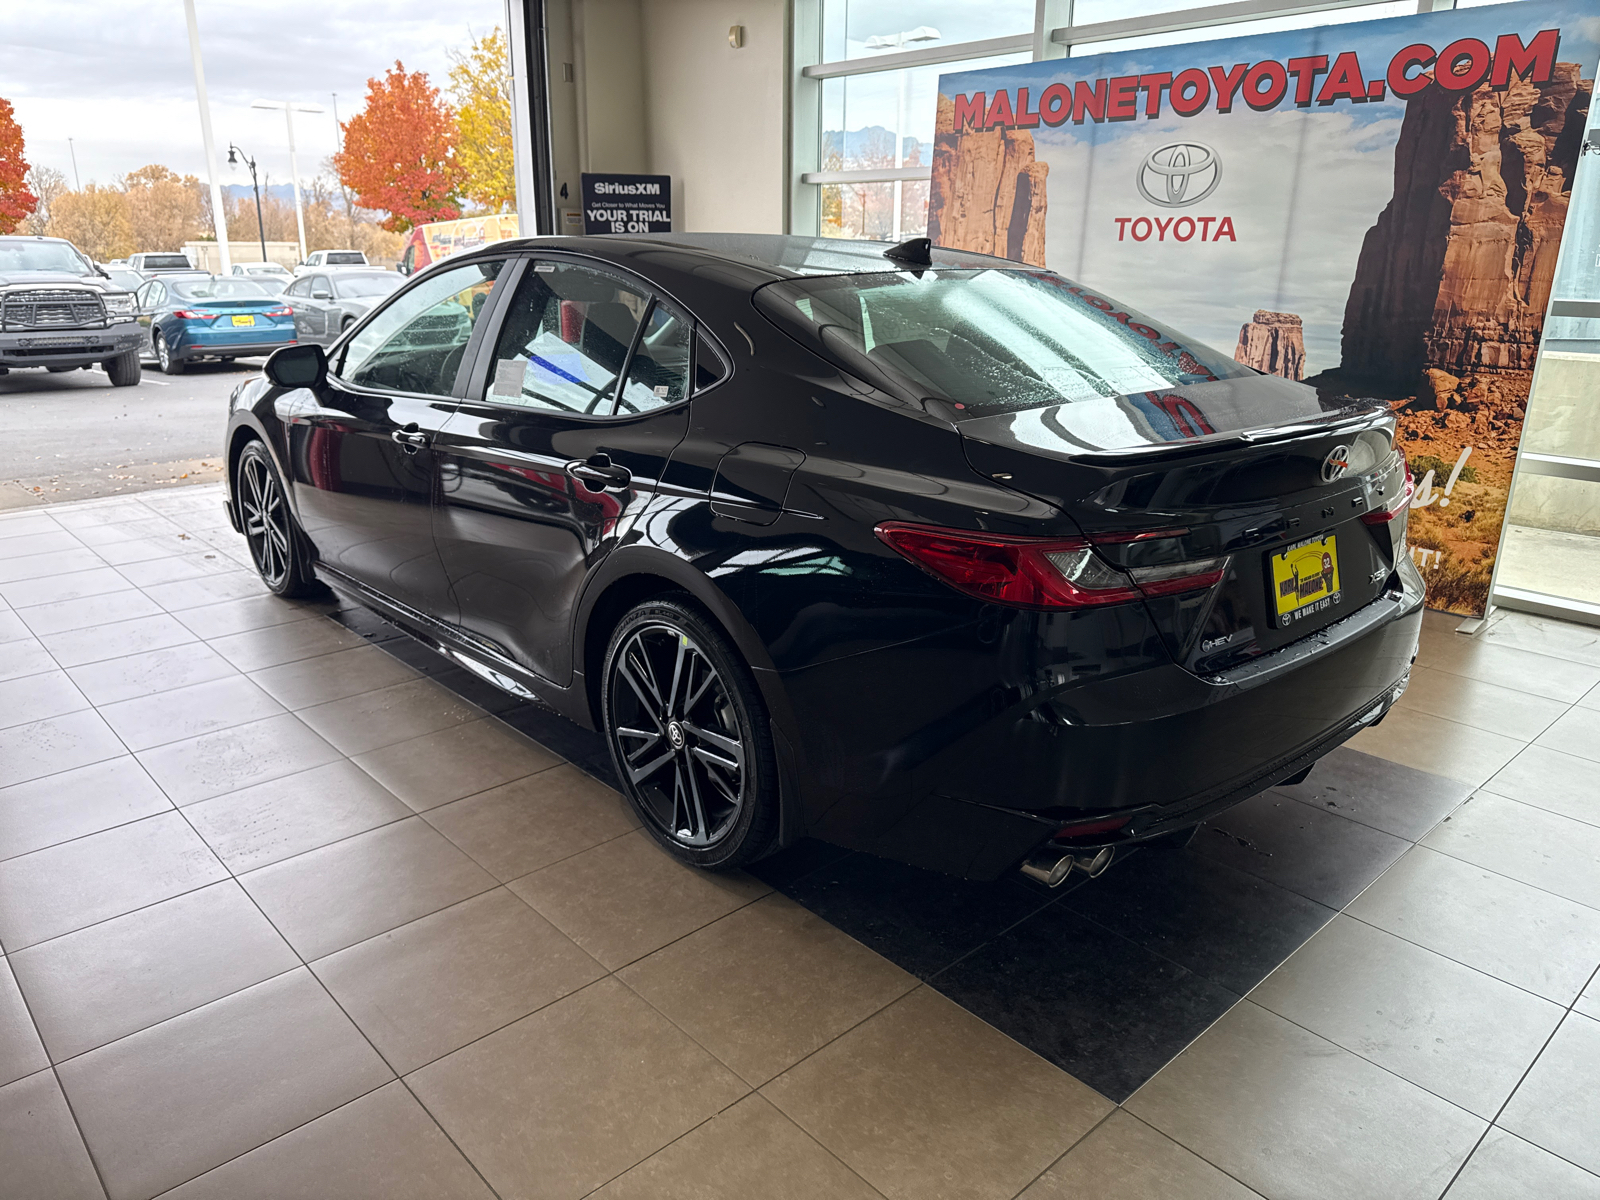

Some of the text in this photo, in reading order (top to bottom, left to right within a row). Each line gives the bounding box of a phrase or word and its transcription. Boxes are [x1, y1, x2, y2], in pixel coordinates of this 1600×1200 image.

[953, 29, 1561, 132] MALONETOYOTA.COM
[560, 182, 569, 200] 4
[594, 182, 660, 195] SiriusXM
[586, 209, 627, 221] YOUR
[629, 210, 671, 222] TRIAL
[611, 221, 649, 233] IS ON
[1115, 217, 1237, 242] TOYOTA
[1323, 557, 1331, 569] 32
[1300, 576, 1323, 599] MALONE
[1294, 610, 1302, 620] WE
[1320, 597, 1330, 609] EASY
